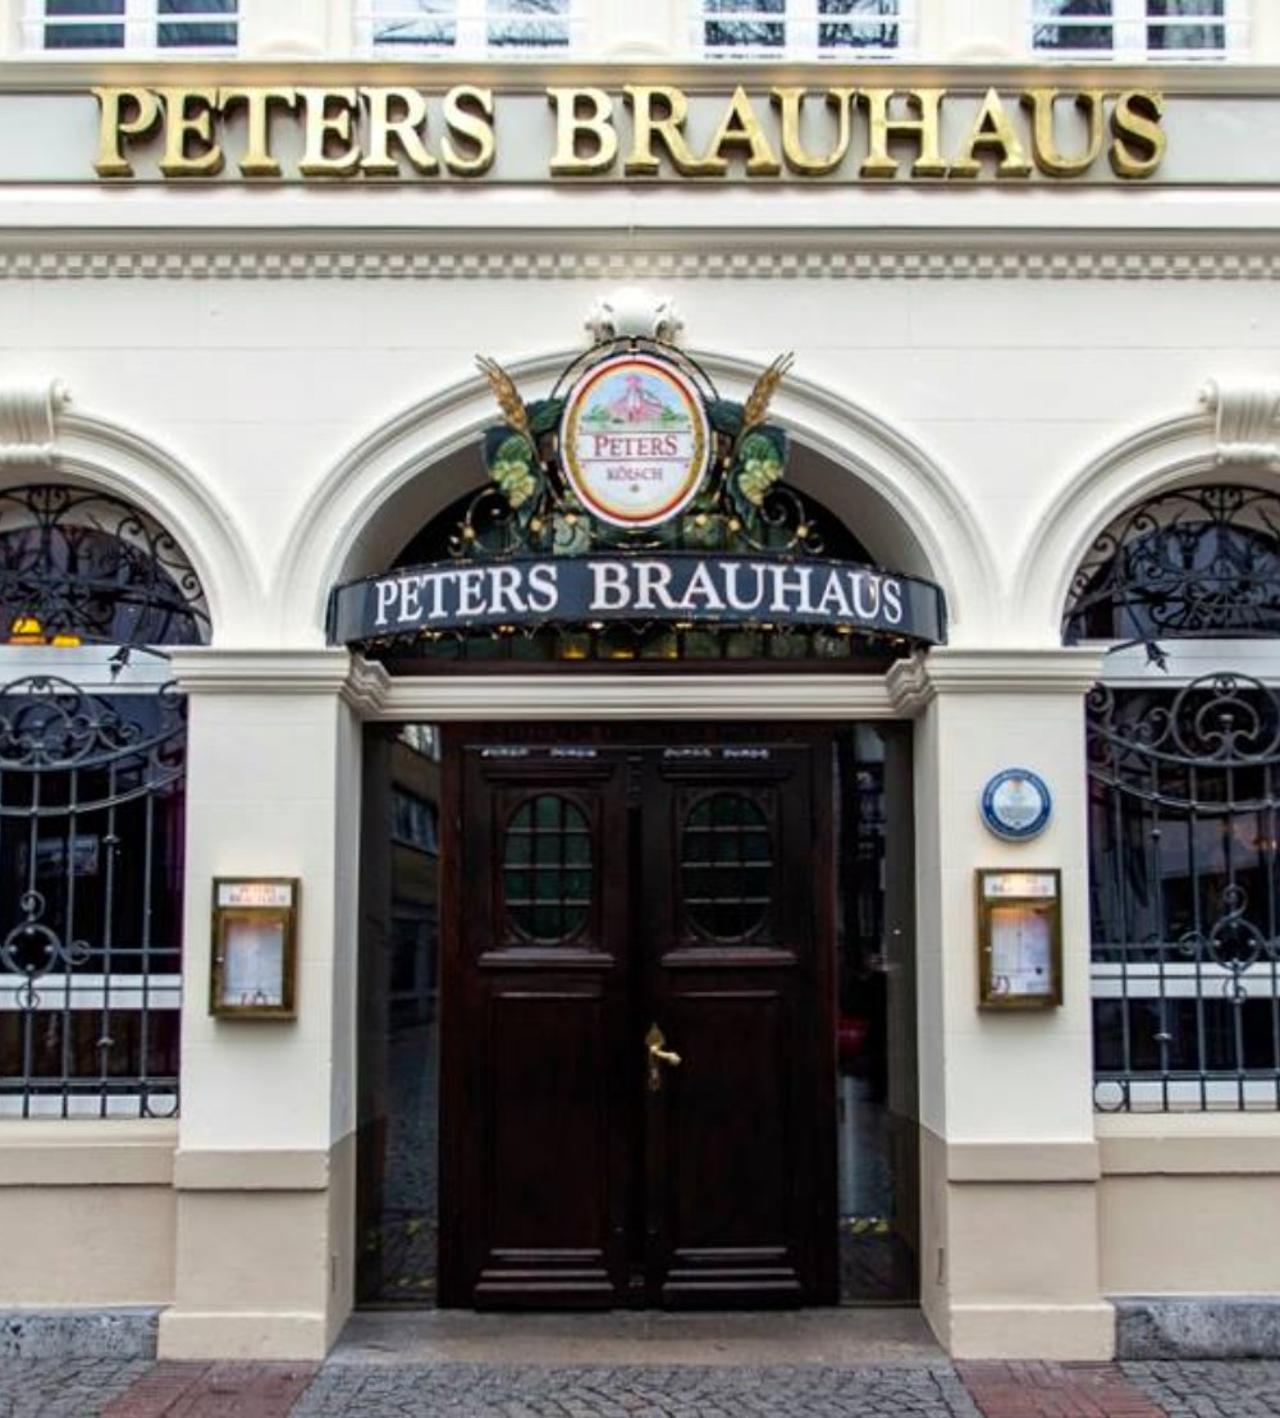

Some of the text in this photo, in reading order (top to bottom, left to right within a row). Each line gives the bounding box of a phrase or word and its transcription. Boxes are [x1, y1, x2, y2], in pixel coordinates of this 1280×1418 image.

[91, 85, 1168, 178] PETERS BRAUHAUS
[593, 434, 678, 457] PETERS
[374, 561, 904, 626] PETERS BRAUHAUS
